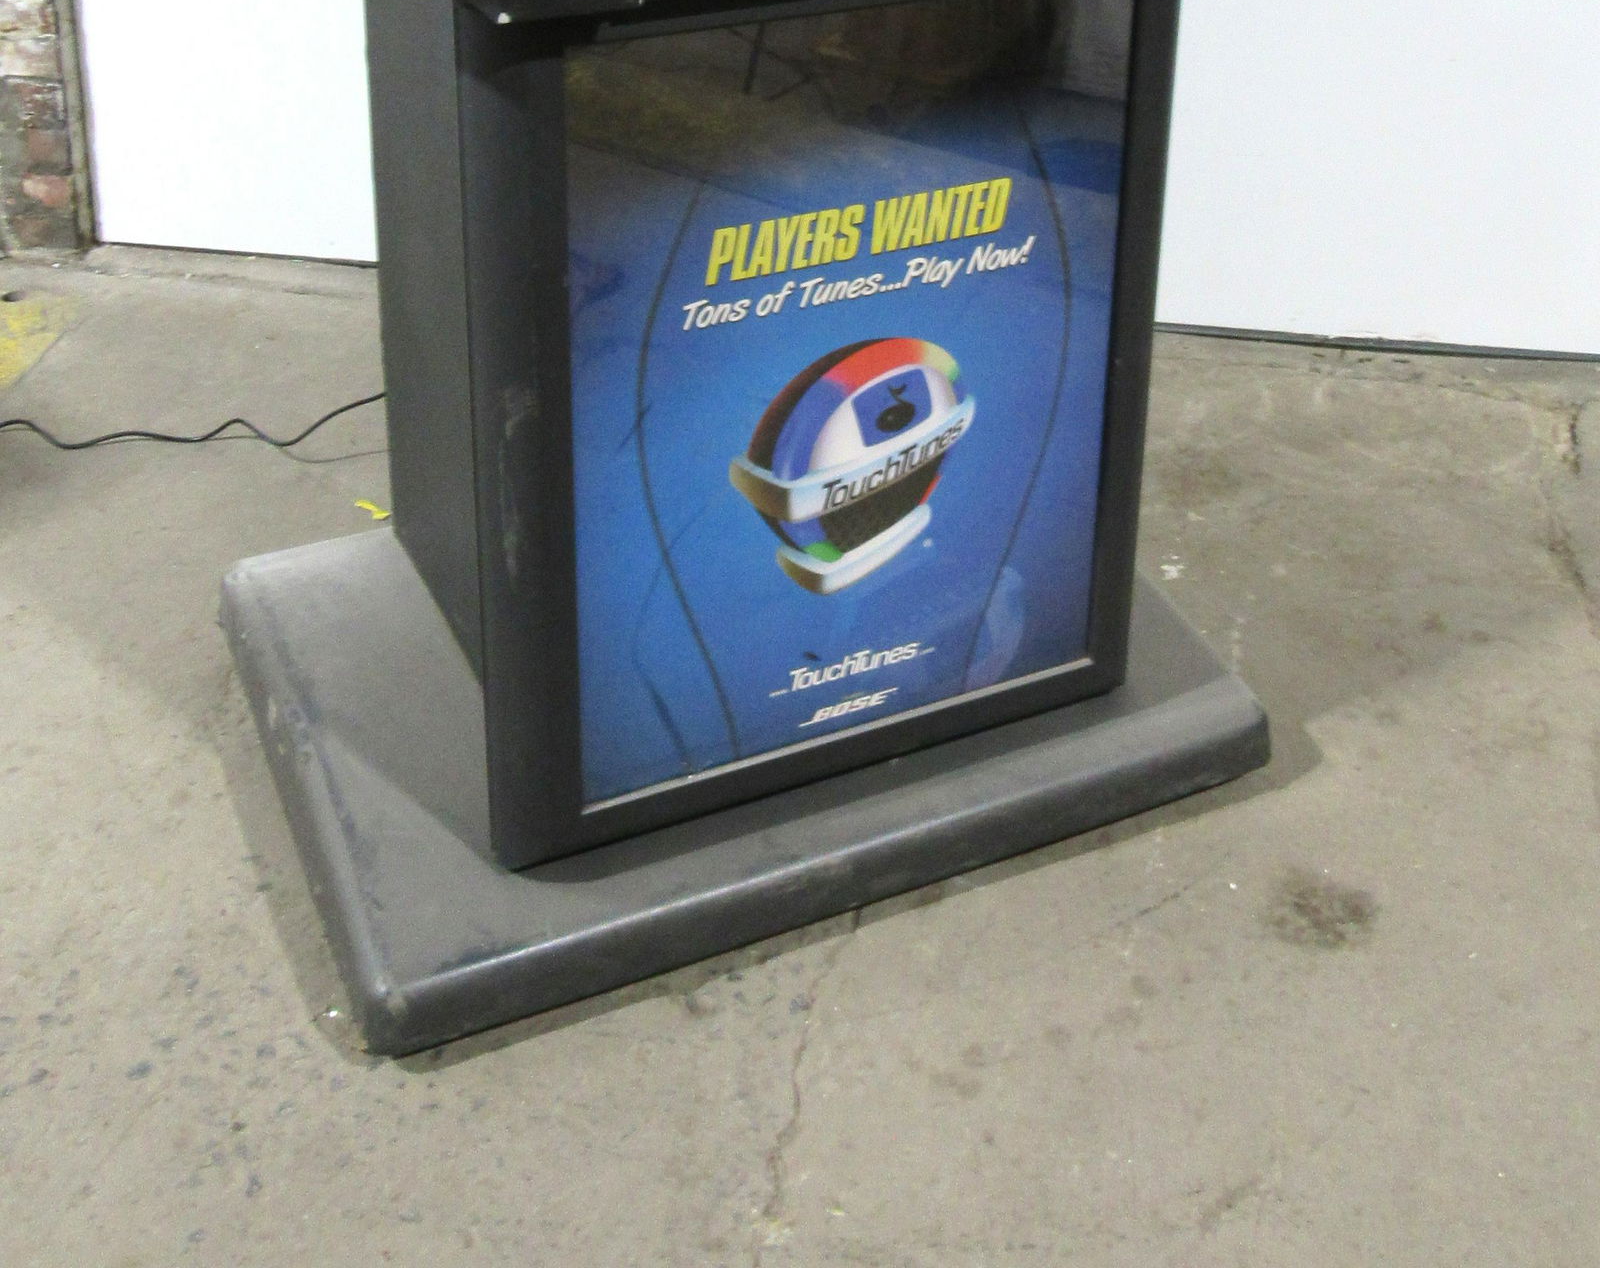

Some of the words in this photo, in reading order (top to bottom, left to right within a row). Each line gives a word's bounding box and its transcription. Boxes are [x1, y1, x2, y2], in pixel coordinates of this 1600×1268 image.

[705, 204, 866, 286] PLAYERS
[870, 177, 1013, 255] WANTED
[682, 299, 751, 332] Tons
[755, 281, 795, 318] of
[966, 235, 1036, 275] Now!
[821, 418, 965, 511] TouchTunes
[789, 642, 922, 692] TouchTunes
[799, 687, 899, 728] BOSE
